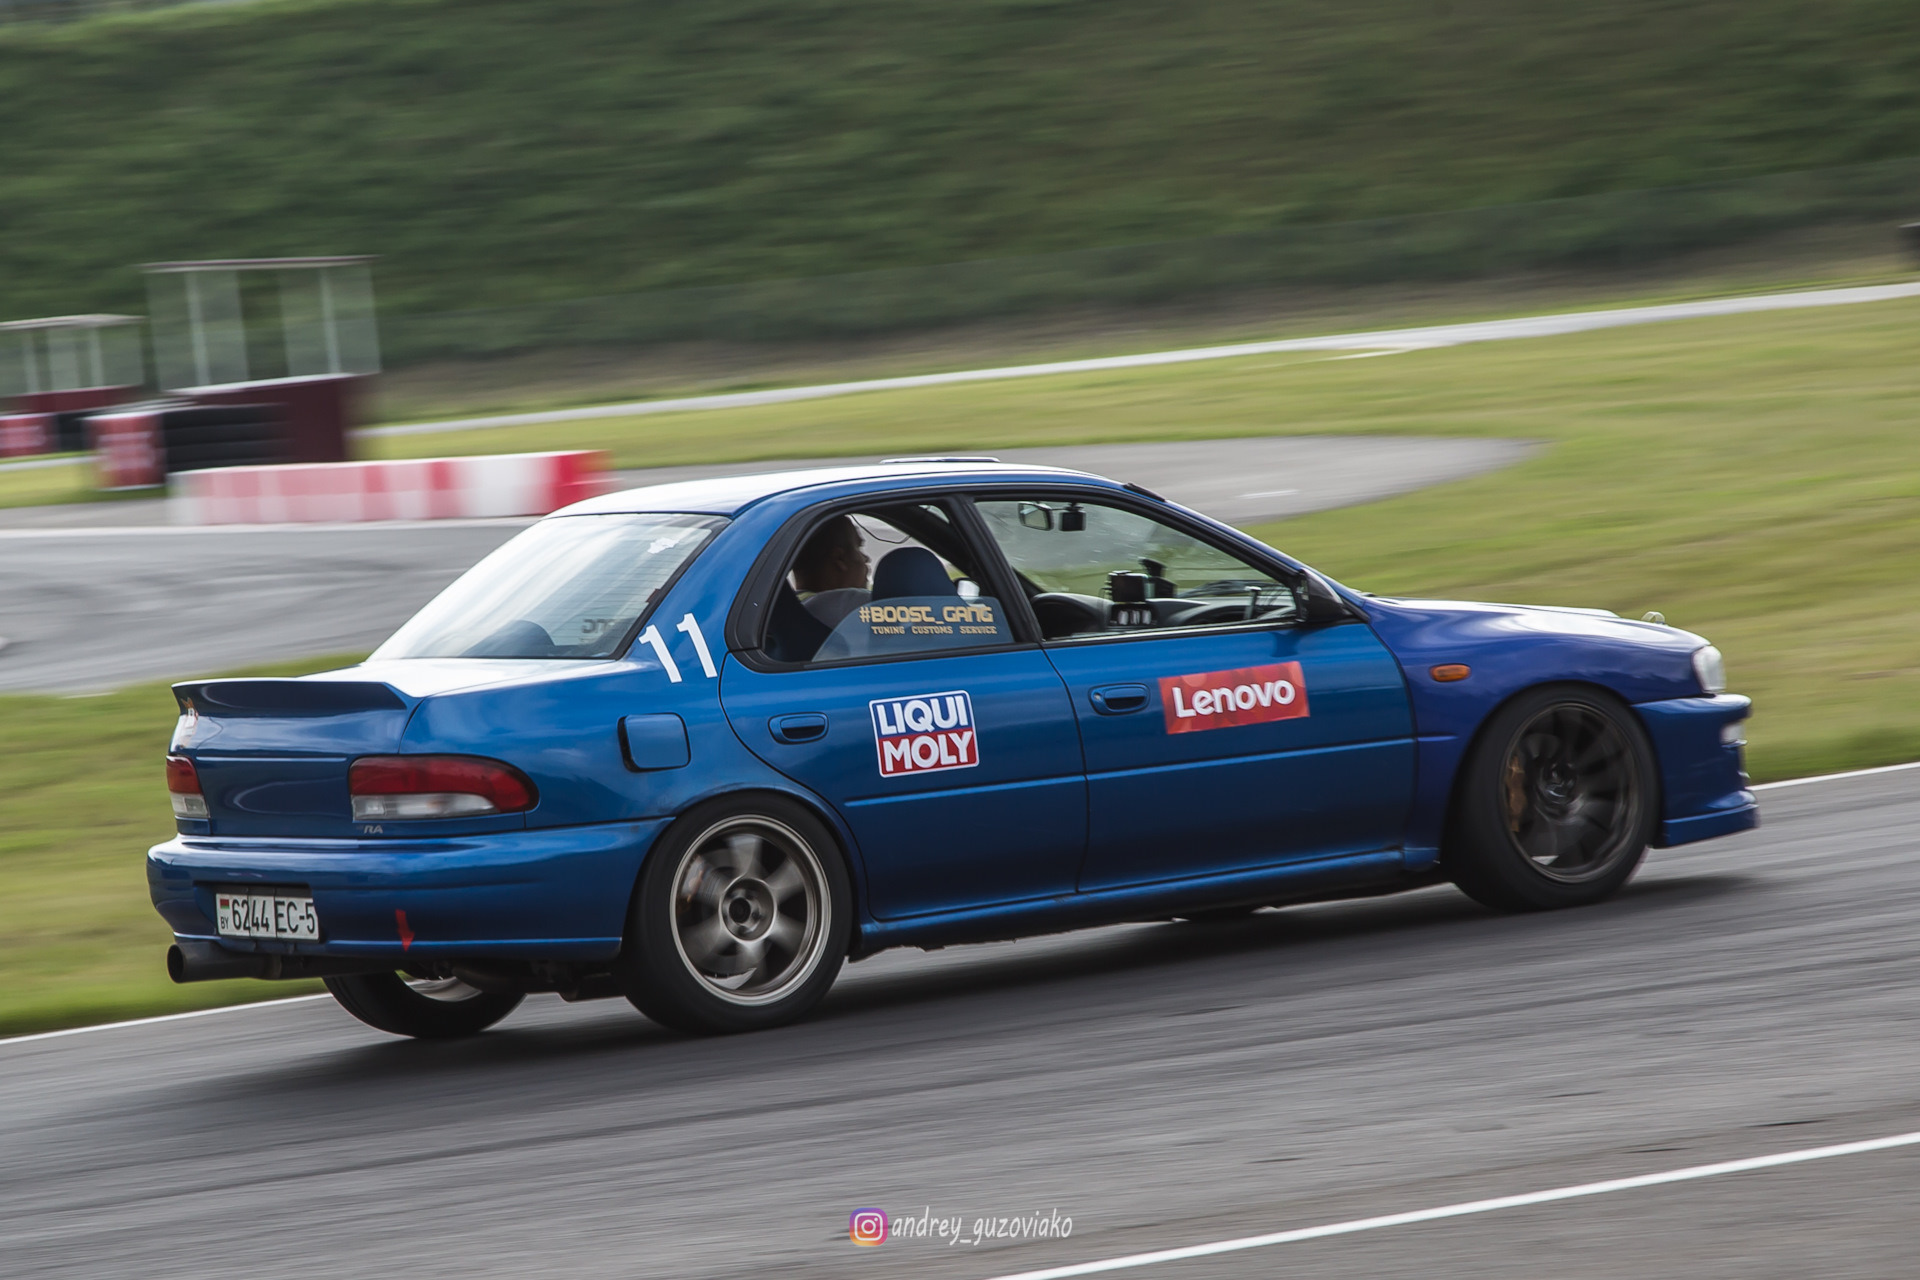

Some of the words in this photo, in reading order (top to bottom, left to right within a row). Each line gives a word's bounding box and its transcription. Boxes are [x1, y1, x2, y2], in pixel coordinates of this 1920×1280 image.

[859, 605, 994, 625] #BOOST_GANG
[871, 626, 905, 635] TUNING
[911, 626, 953, 635] CUSTOMS
[959, 626, 998, 635] SERVICE
[638, 612, 718, 683] 11
[876, 695, 968, 735] LIQUI
[1172, 680, 1295, 718] Lenovo
[883, 730, 973, 772] MOLY
[220, 917, 229, 929] BY
[232, 899, 269, 932] 6244
[275, 901, 315, 934] EC-5
